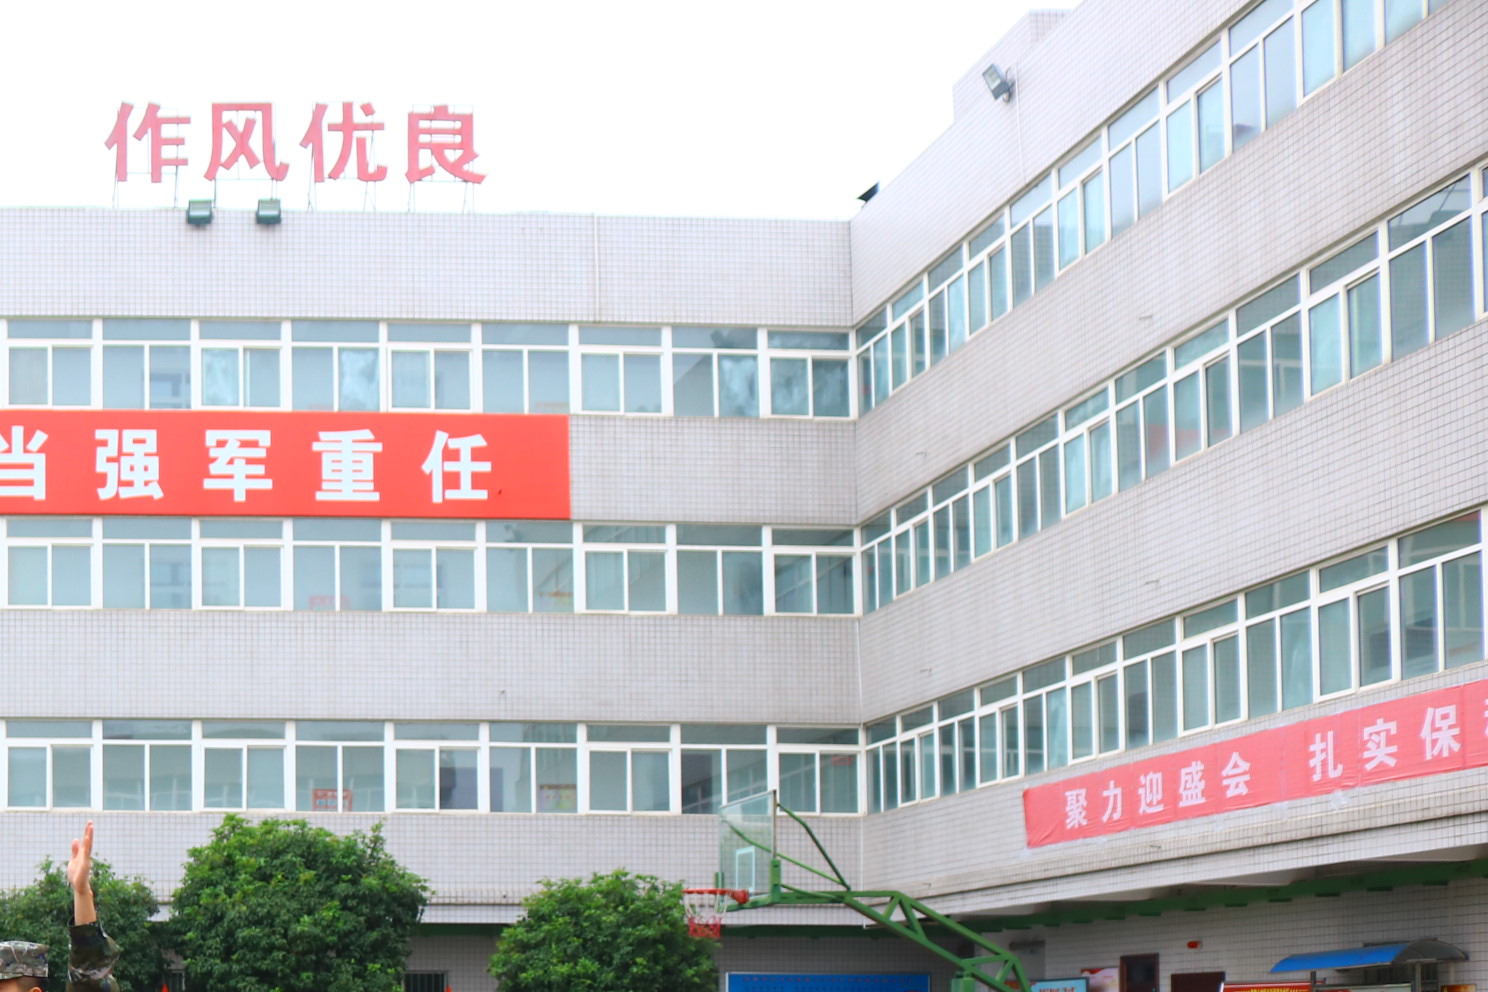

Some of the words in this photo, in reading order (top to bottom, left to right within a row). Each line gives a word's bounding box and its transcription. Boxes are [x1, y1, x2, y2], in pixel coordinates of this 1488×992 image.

[105, 101, 487, 184] 作风优良
[1065, 751, 1251, 830] 聚力迎盛会
[1309, 698, 1488, 782] 扎实保
